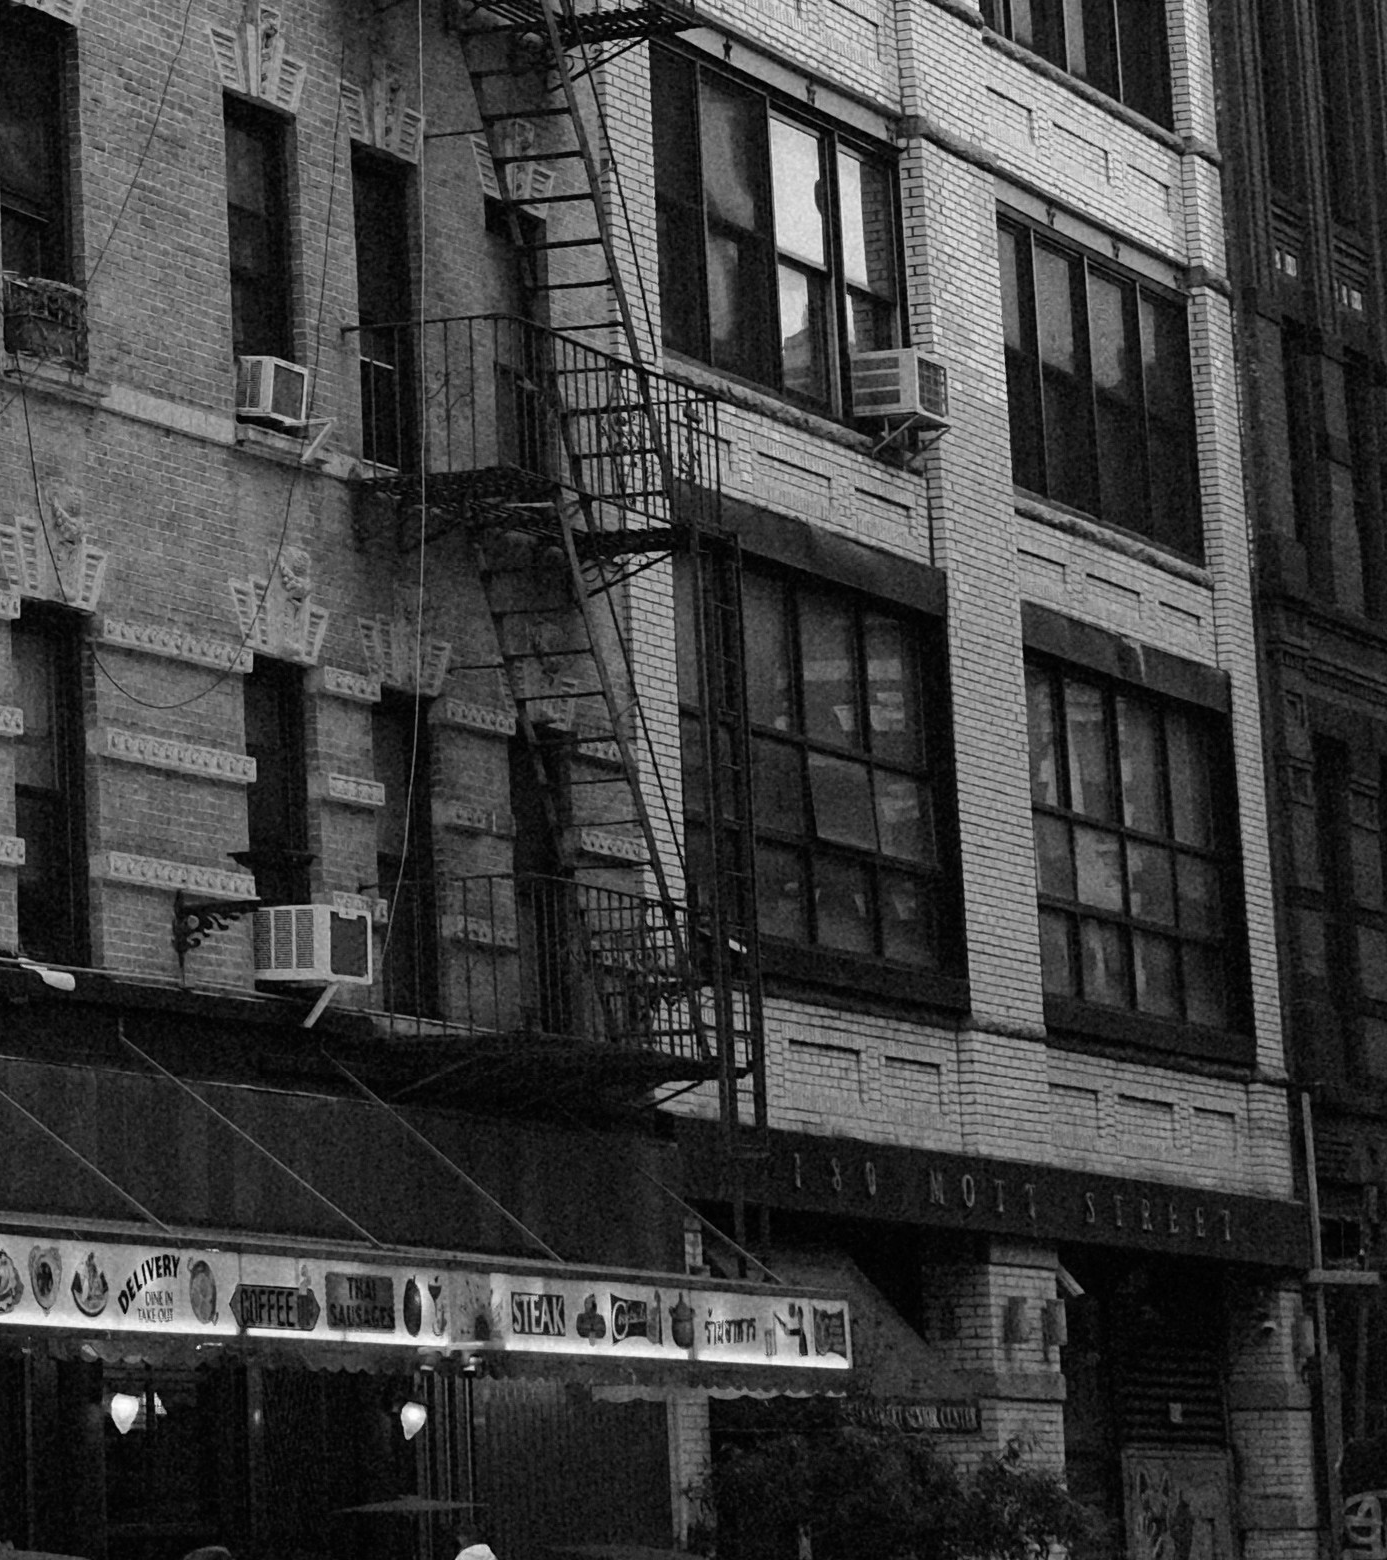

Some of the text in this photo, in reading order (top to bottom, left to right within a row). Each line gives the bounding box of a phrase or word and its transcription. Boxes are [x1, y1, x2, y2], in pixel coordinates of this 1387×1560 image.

[928, 1166, 1038, 1221] MOTT
[1084, 1190, 1233, 1242] STREET
[117, 1253, 181, 1315] DELIVERY
[144, 1290, 174, 1307] DINE IN
[346, 1276, 377, 1301] THAI
[137, 1307, 156, 1323] TAKE
[239, 1289, 296, 1328] COFFEE
[328, 1303, 396, 1329] SAUSAGES
[512, 1294, 565, 1336] STEAK
